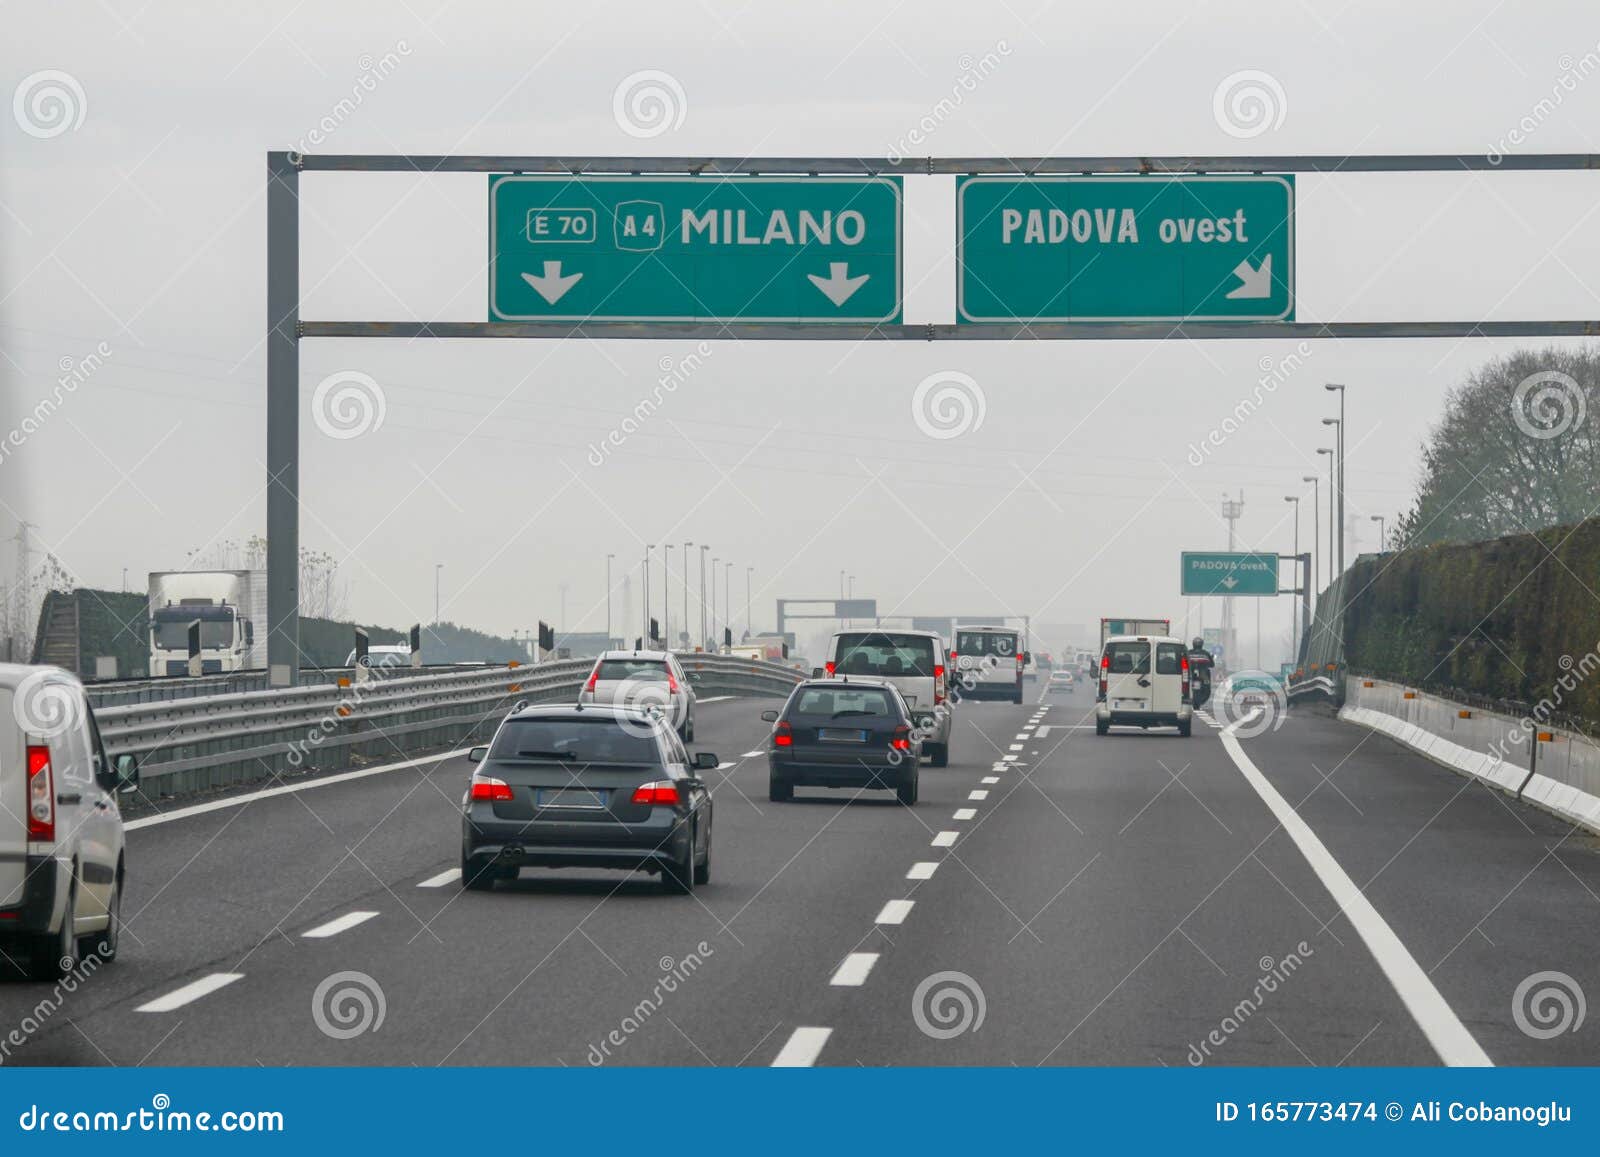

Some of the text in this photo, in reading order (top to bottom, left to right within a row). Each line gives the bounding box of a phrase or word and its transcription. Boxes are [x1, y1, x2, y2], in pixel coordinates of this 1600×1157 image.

[535, 216, 588, 235] E 70
[623, 215, 656, 237] A 4
[681, 208, 866, 246] MILANO
[1002, 208, 1249, 244] PADOVA ovest
[1192, 560, 1237, 570] PADOVA
